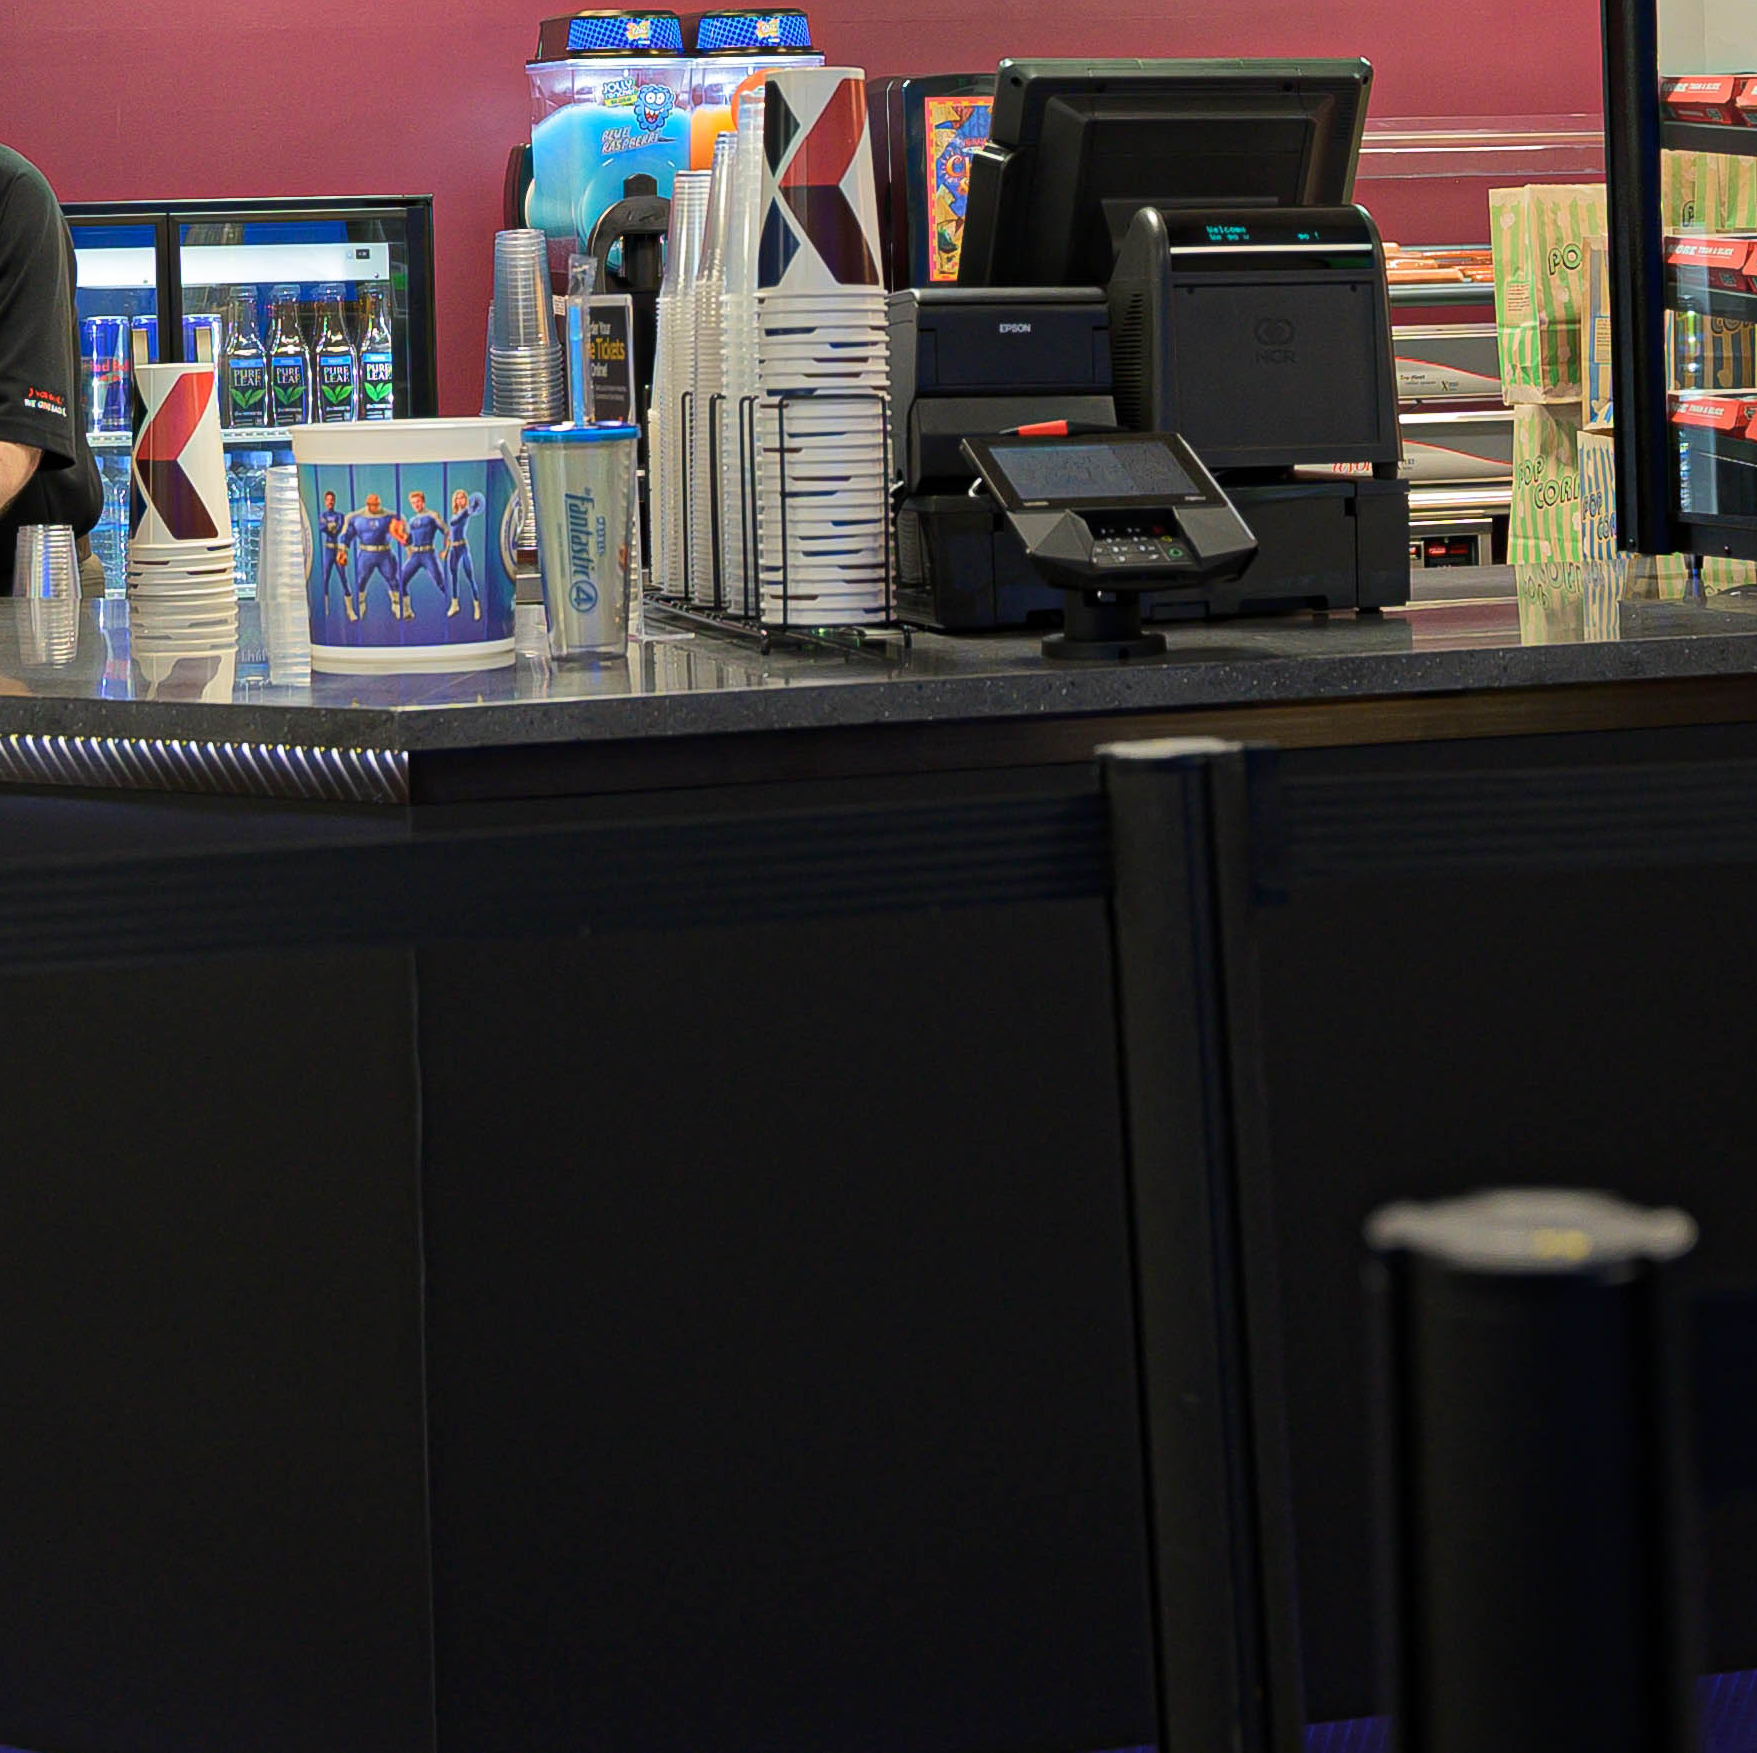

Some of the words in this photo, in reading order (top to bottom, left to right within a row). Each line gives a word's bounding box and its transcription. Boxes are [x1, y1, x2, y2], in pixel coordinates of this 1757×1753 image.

[595, 337, 626, 362] Tickets
[276, 366, 300, 376] PURE
[323, 366, 349, 376] PURE
[1517, 456, 1544, 491] POP
[566, 491, 595, 580] Fantastic
